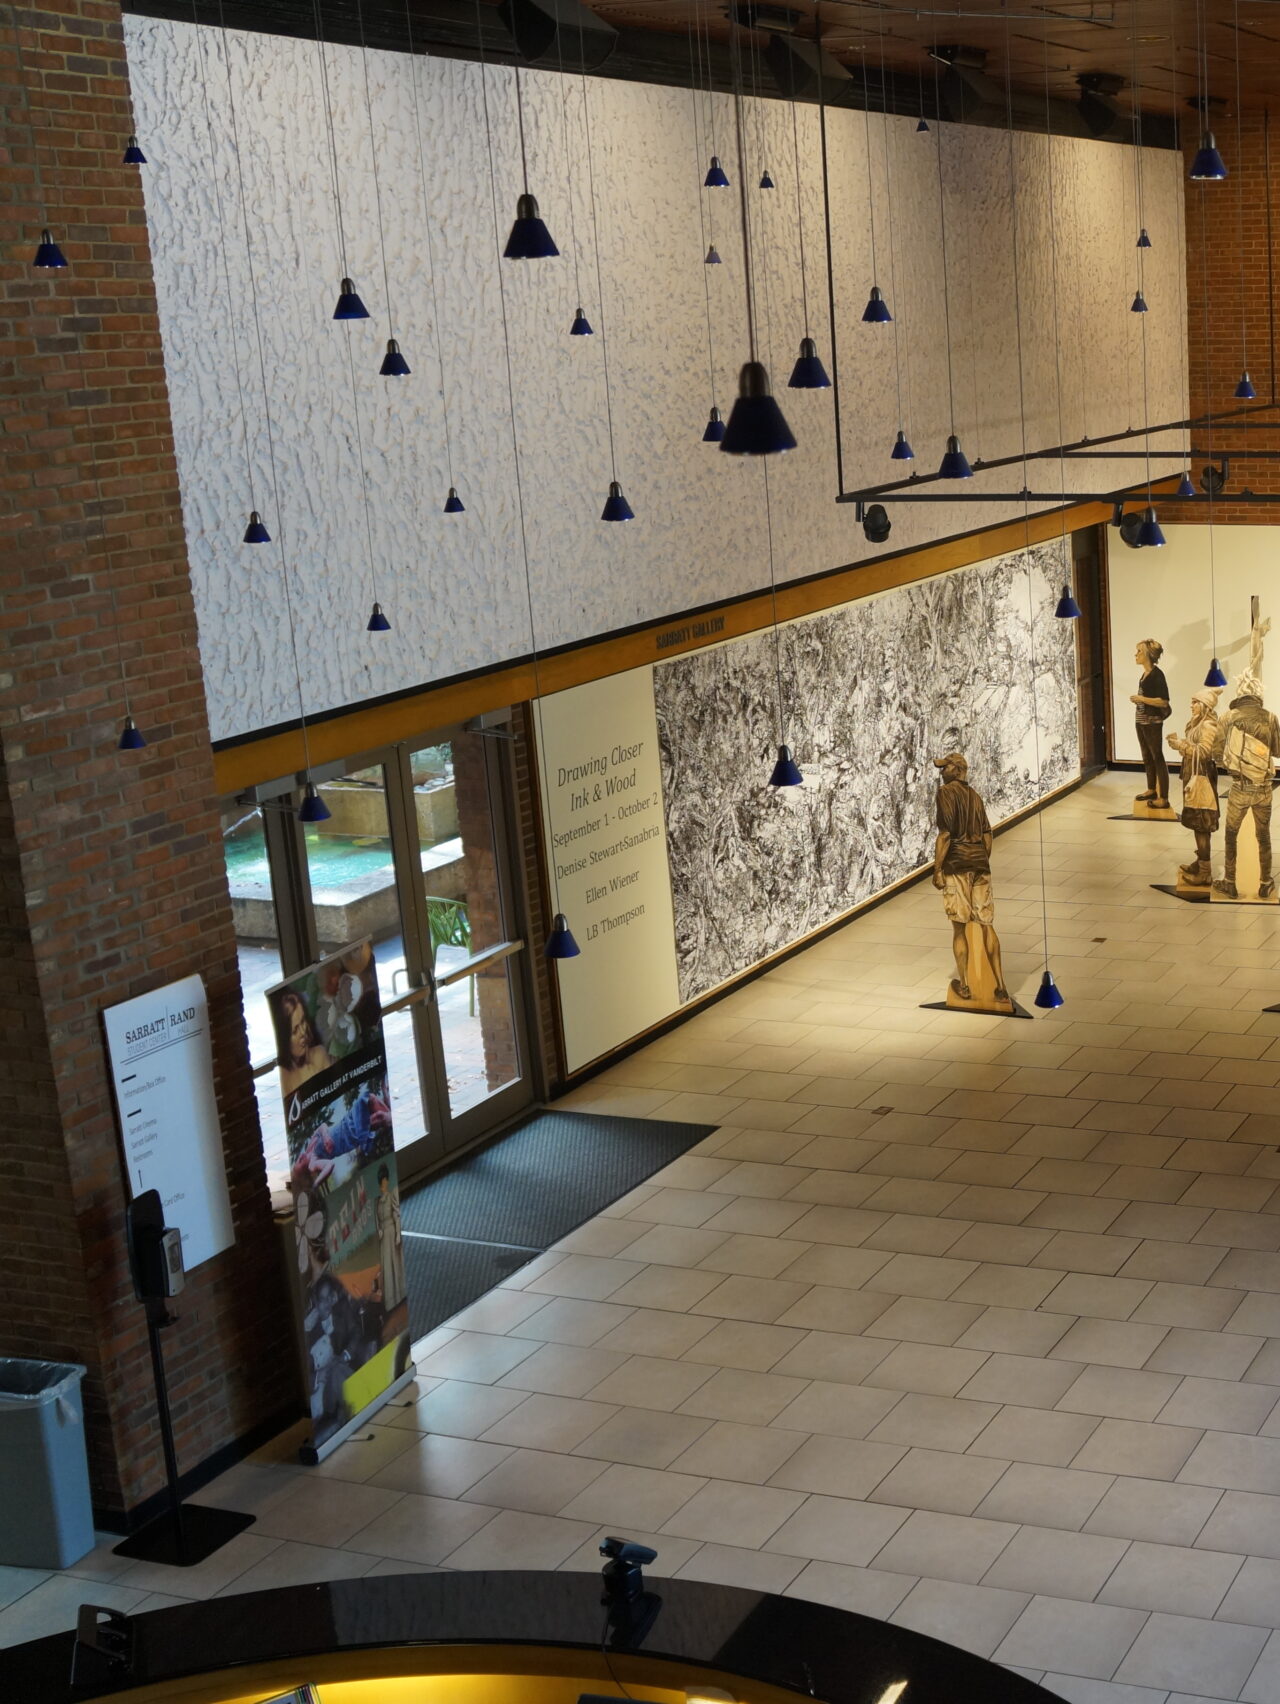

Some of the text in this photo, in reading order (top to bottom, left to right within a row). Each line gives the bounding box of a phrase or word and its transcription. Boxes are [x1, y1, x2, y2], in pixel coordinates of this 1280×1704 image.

[557, 742, 644, 788] Drawing Closer
[570, 767, 636, 812] Ink & Wood
[553, 819, 601, 848] September
[604, 812, 609, 827] 1
[617, 799, 650, 820] October
[653, 791, 658, 806] 2
[557, 825, 660, 880] Denise Stewart-Sanabria
[585, 870, 640, 904] Ellen Wiener
[586, 904, 646, 941] LB Thompson
[125, 1007, 195, 1045] SARRATT RAND
[320, 1079, 342, 1098] GALLERY
[342, 1073, 349, 1084] AT
[349, 1055, 382, 1079] VANDERBILT
